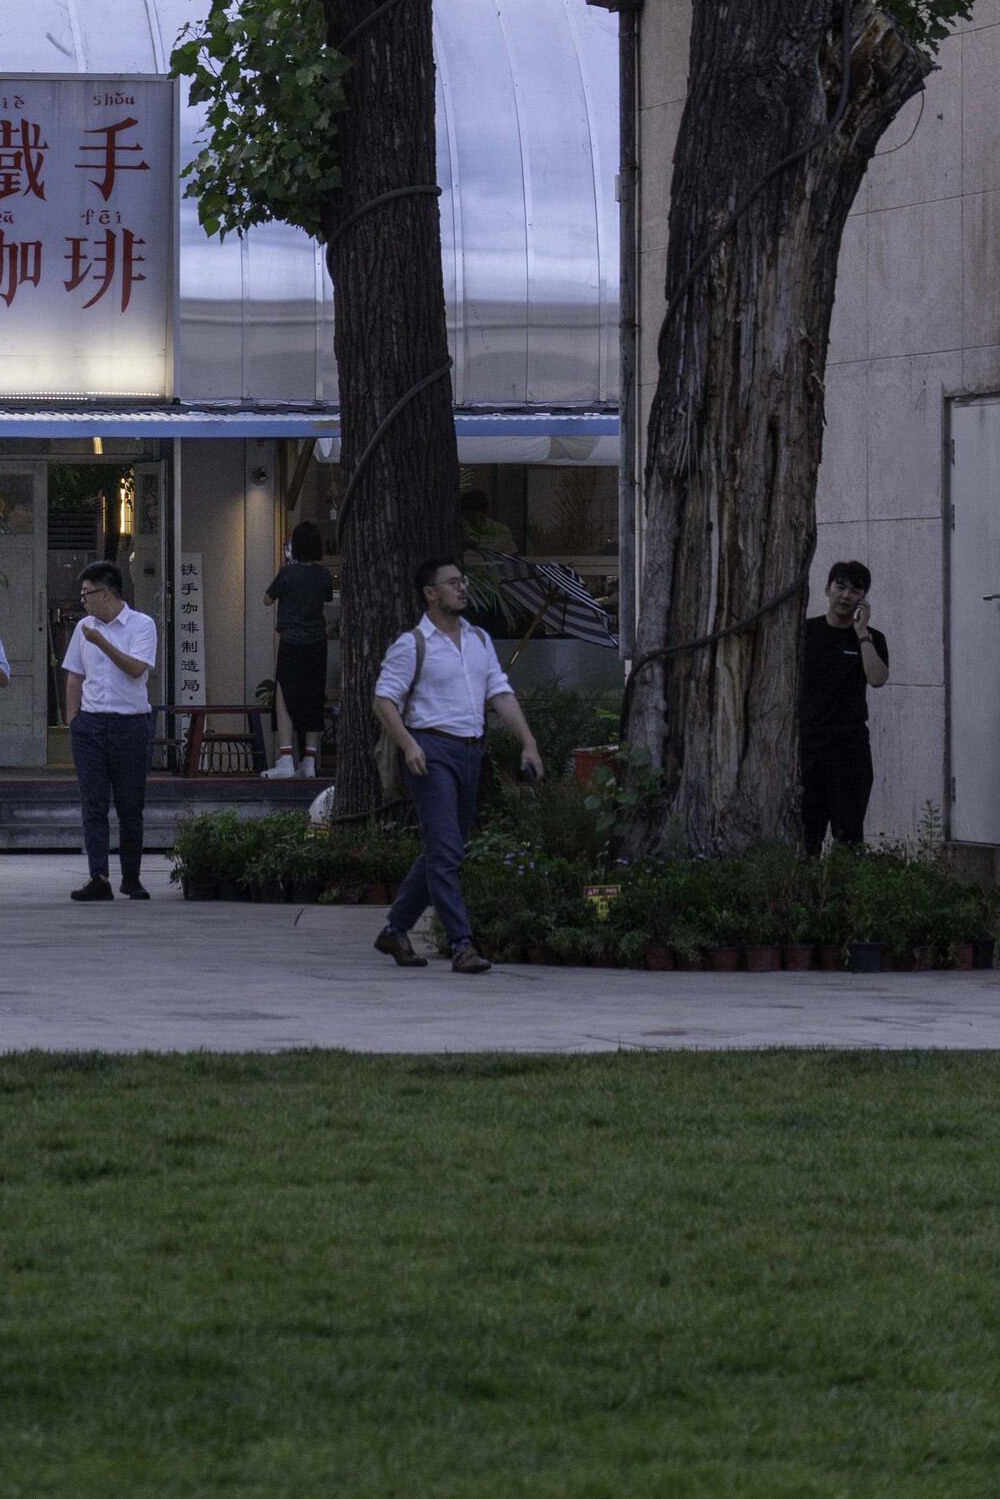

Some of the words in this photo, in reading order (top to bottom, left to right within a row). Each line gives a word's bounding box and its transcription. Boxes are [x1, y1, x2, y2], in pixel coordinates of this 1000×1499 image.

[93, 92, 135, 106] shǒu
[81, 209, 122, 225] fēi
[181, 563, 200, 749] 铁手咖啡制造局·
